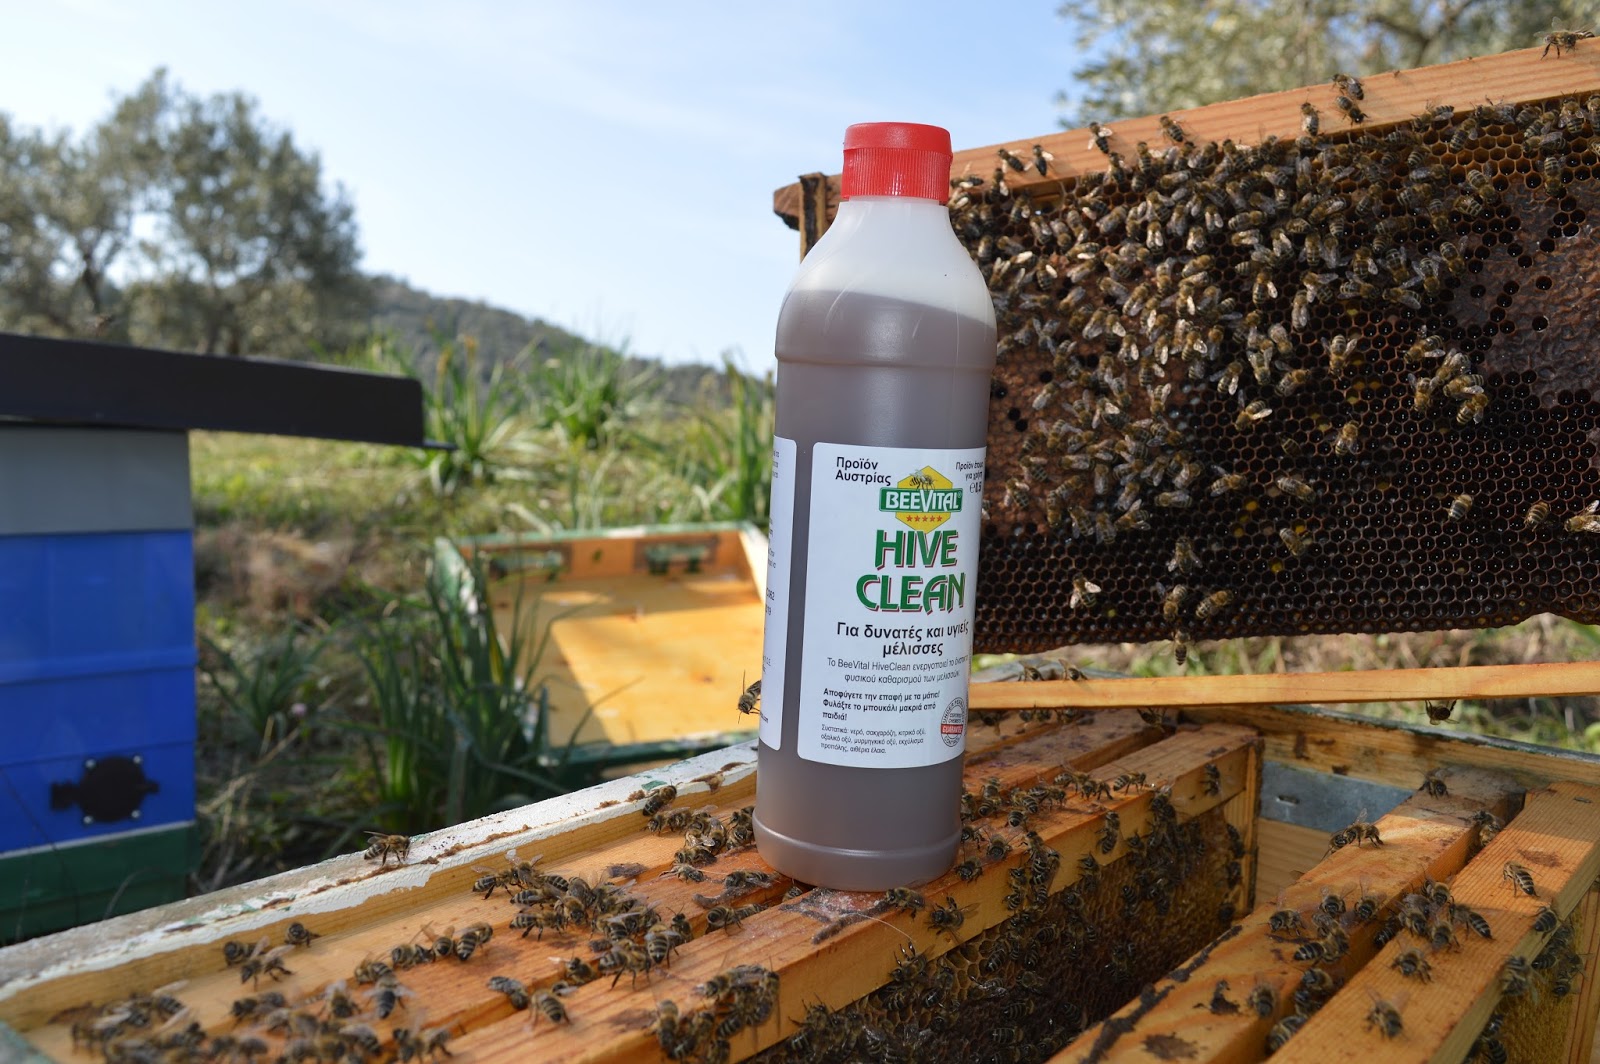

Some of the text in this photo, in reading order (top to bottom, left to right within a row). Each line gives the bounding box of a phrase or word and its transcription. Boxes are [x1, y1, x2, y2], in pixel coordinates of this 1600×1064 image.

[836, 456, 879, 470] Προϊόν
[835, 469, 892, 486] Αυστρίας
[874, 529, 959, 571] HIVE
[856, 572, 966, 615] CLEAN
[837, 619, 969, 642] Για δυνατές και υγιείς
[882, 641, 944, 658] μέλισσες
[827, 657, 836, 667] Το
[838, 658, 870, 670] BeeVital
[872, 661, 911, 671] HiveClean
[912, 659, 949, 672] ενεργοποιεί
[844, 674, 876, 683] φυσικού
[878, 674, 922, 686] καθαρισμού
[923, 675, 936, 683] των
[823, 687, 863, 700] Αποφύγετε
[864, 693, 878, 702] την
[878, 692, 903, 702] επαφή
[904, 694, 912, 702] με
[822, 698, 937, 714] Φυλάξτε το μπουκάλι μακριά από
[822, 711, 848, 721] παιδιά!
